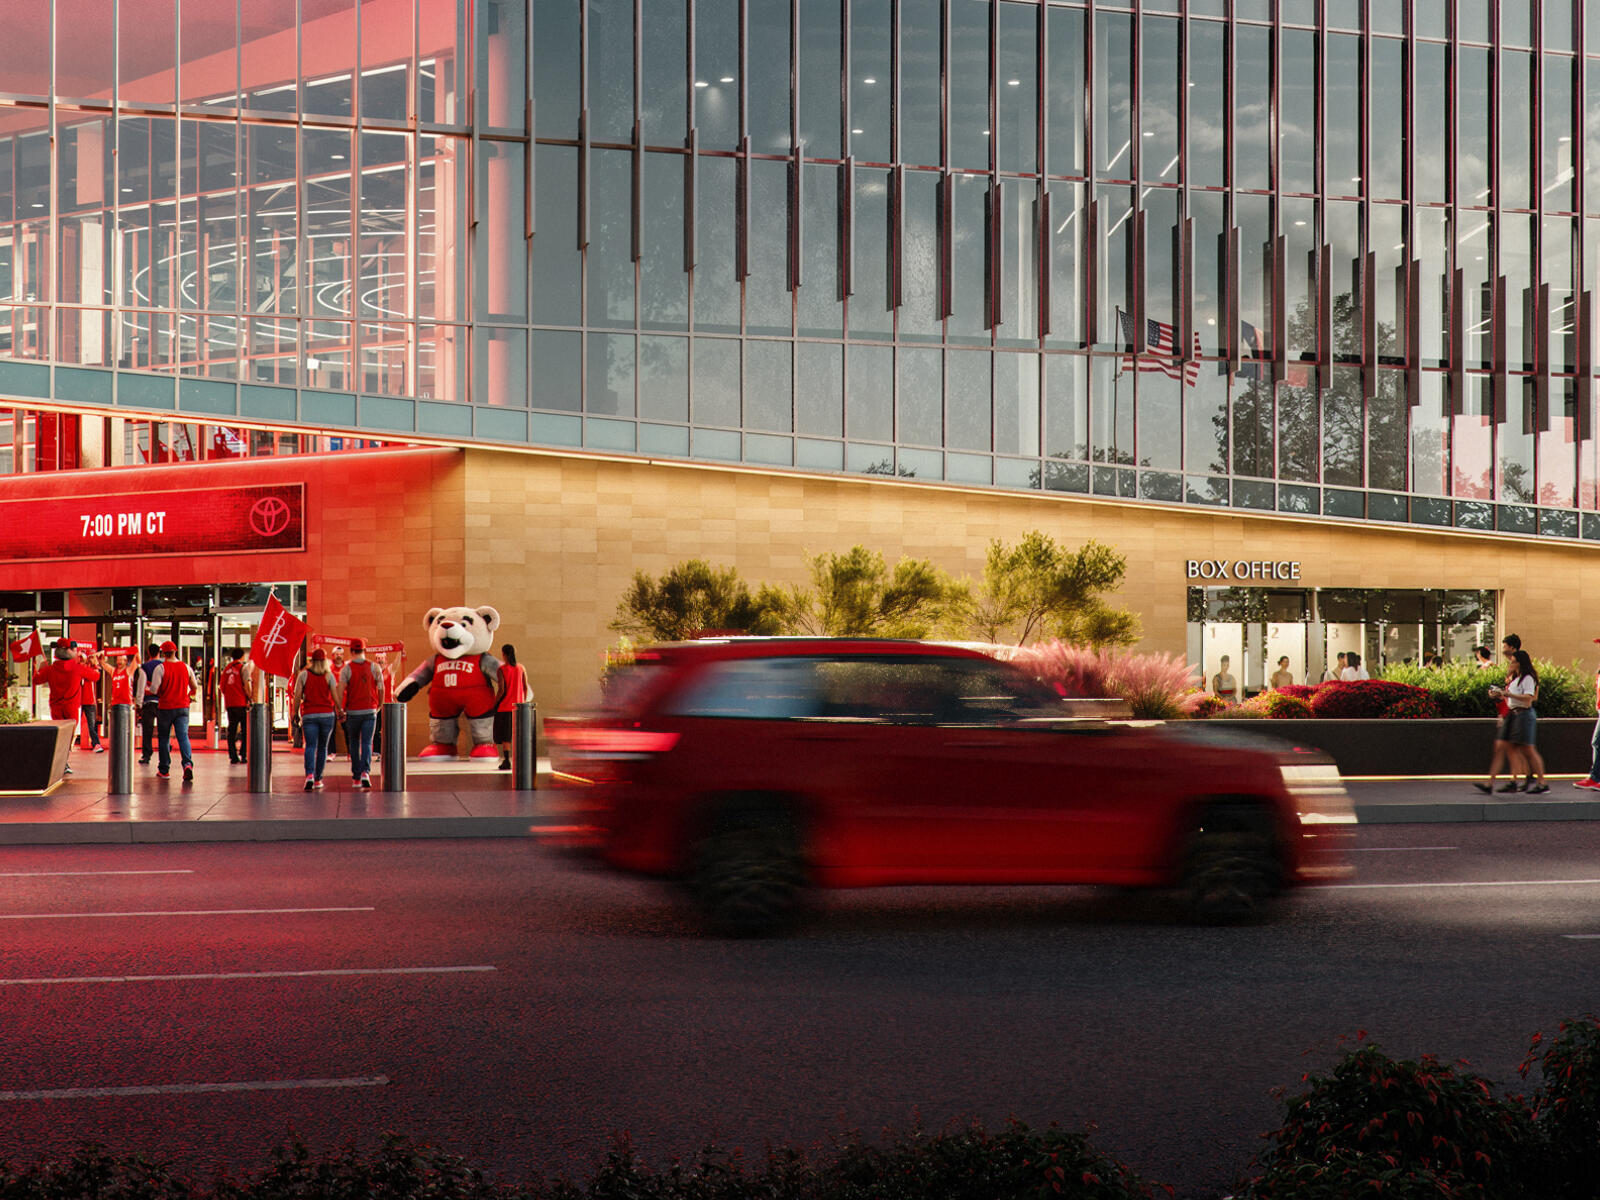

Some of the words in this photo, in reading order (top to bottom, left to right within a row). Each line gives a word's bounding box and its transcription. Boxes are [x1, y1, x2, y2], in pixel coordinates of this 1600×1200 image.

[80, 514, 113, 537] 7:00
[118, 512, 142, 536] PM
[146, 511, 166, 535] CT
[1187, 560, 1230, 579] BOX
[1233, 561, 1301, 580] OFFICE
[1270, 627, 1280, 639] 2
[1331, 627, 1340, 639] 3
[1390, 627, 1400, 639] 4
[444, 673, 458, 688] 00
